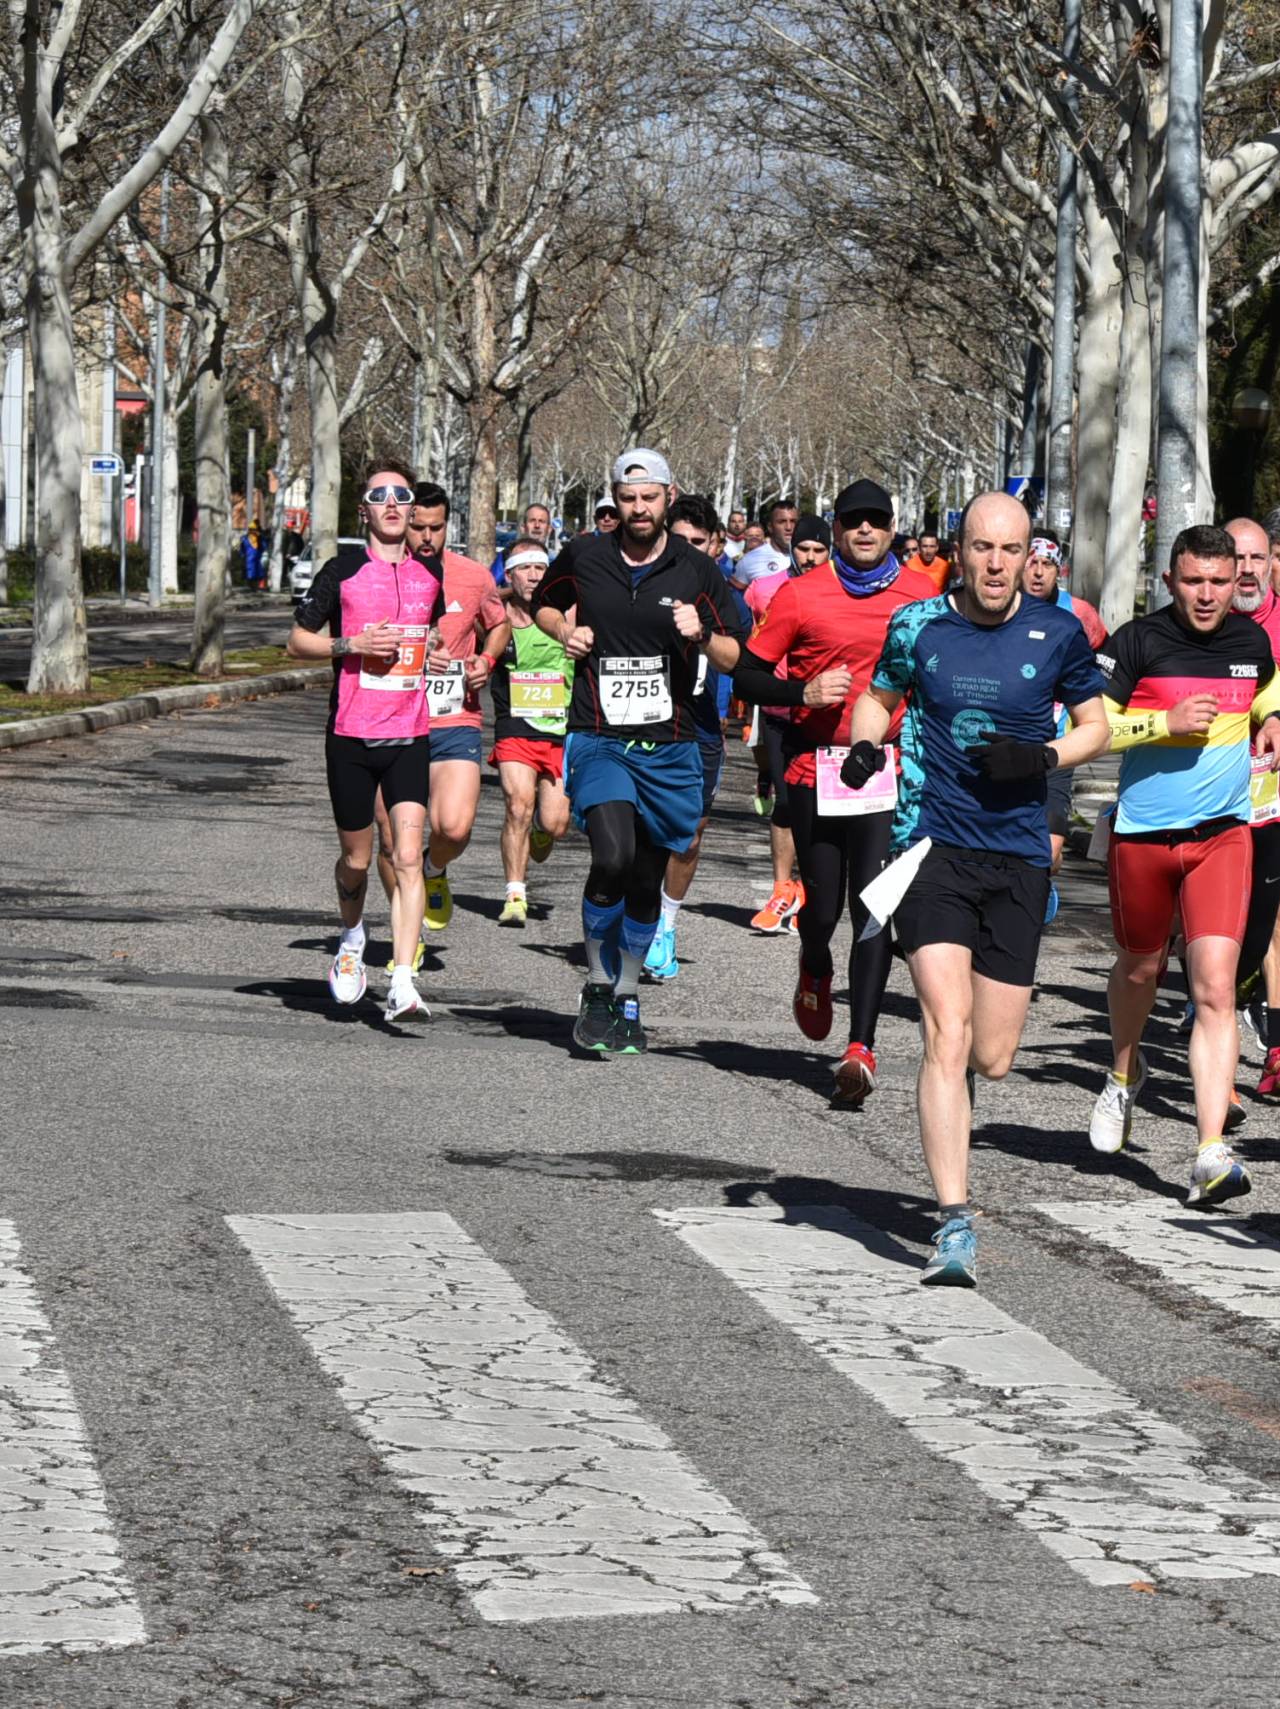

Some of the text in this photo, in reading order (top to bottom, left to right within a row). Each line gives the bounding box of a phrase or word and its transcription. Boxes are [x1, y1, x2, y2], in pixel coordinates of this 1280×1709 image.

[606, 659, 663, 670] SOLISS
[522, 686, 552, 701] 724
[611, 679, 660, 698] 2755
